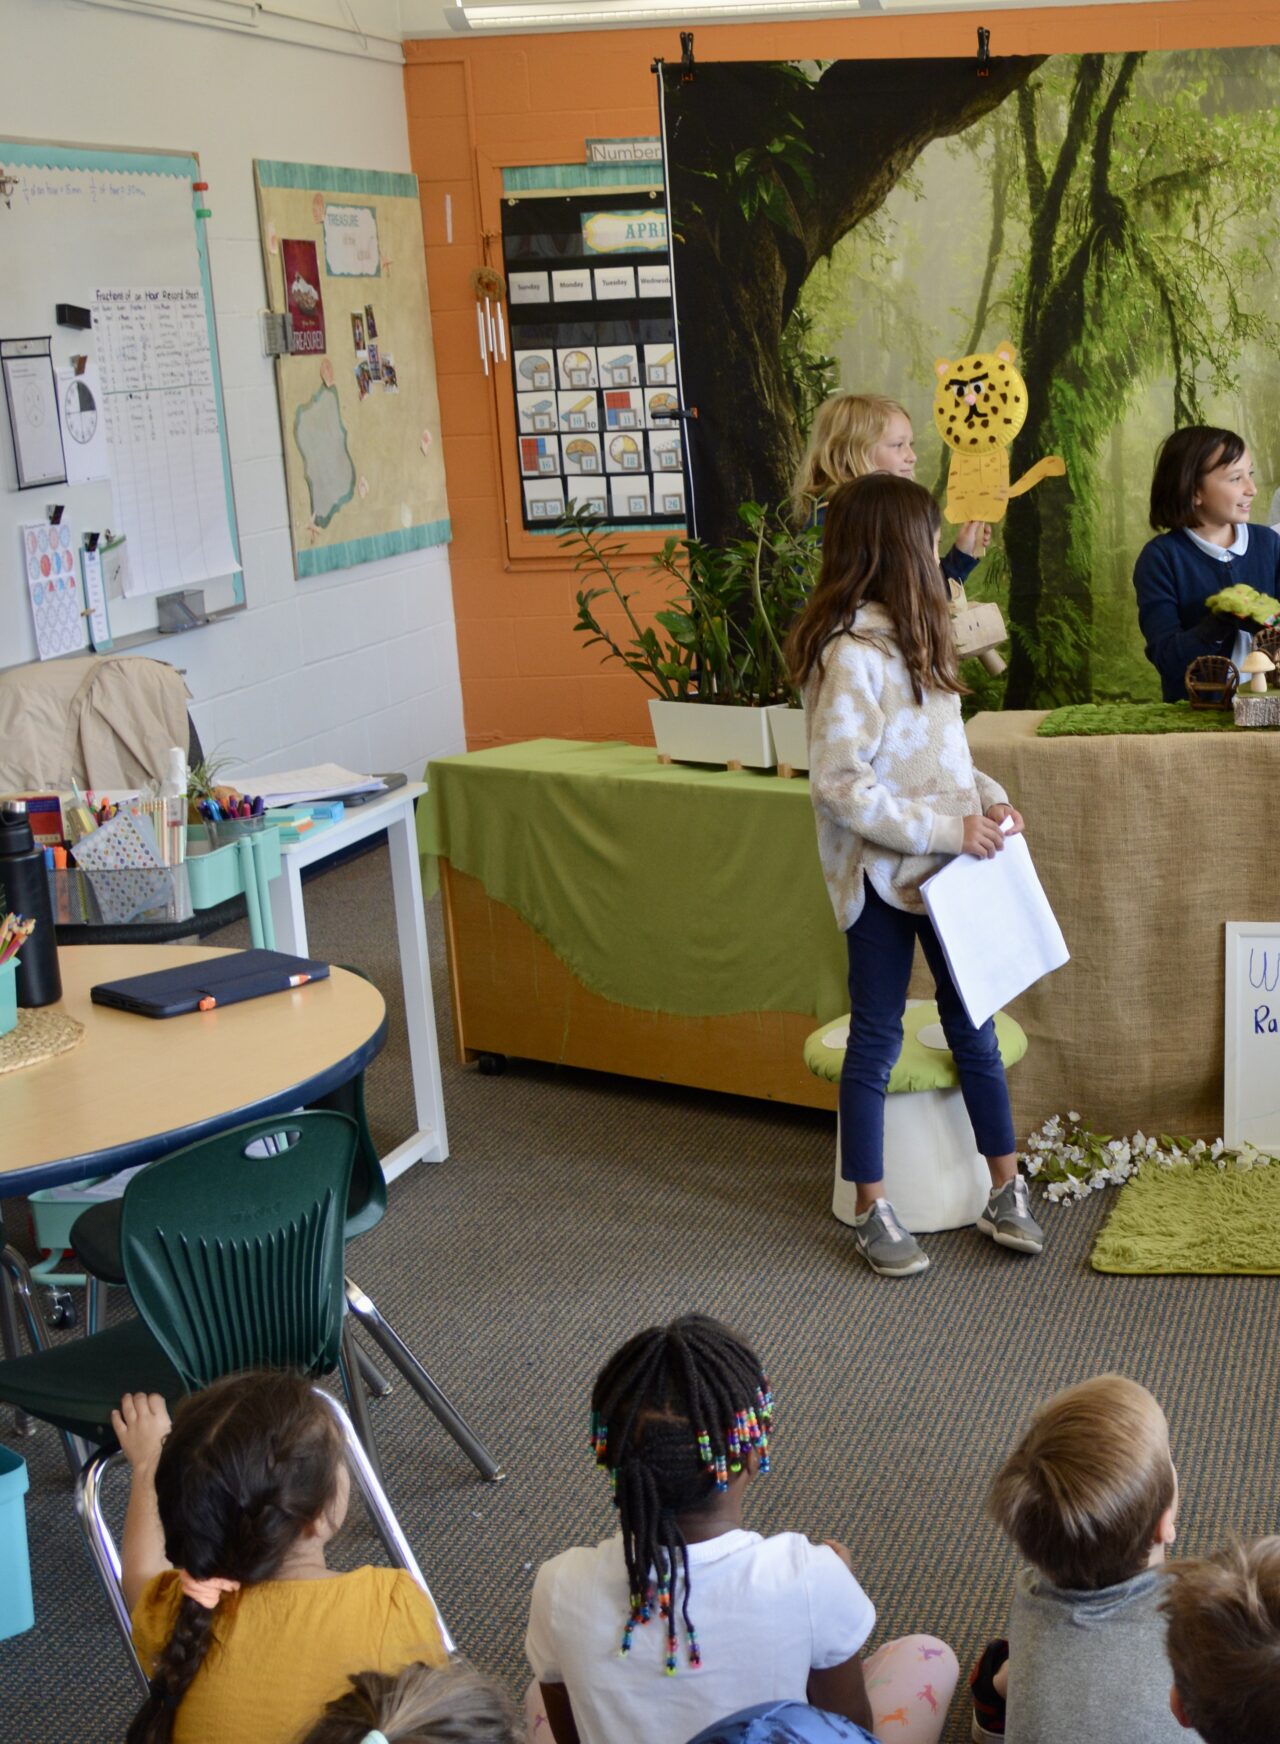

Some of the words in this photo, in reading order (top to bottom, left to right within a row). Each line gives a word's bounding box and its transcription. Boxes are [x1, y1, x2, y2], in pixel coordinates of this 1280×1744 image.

[327, 214, 360, 228] TREASURE
[625, 222, 666, 239] APRI
[560, 281, 584, 289] Monday
[602, 279, 627, 287] Tuesday
[517, 284, 540, 292] Sunday
[145, 290, 159, 301] Hour
[162, 289, 183, 300] Record
[618, 371, 624, 380] 4
[632, 375, 637, 384] 4
[655, 370, 660, 380] 5
[572, 416, 582, 425] 10
[623, 415, 631, 424] 11
[587, 421, 596, 429] 10
[585, 459, 593, 468] 17
[627, 457, 635, 466] 18
[664, 455, 673, 464] 19
[633, 501, 642, 510] 25
[667, 499, 678, 509] 26
